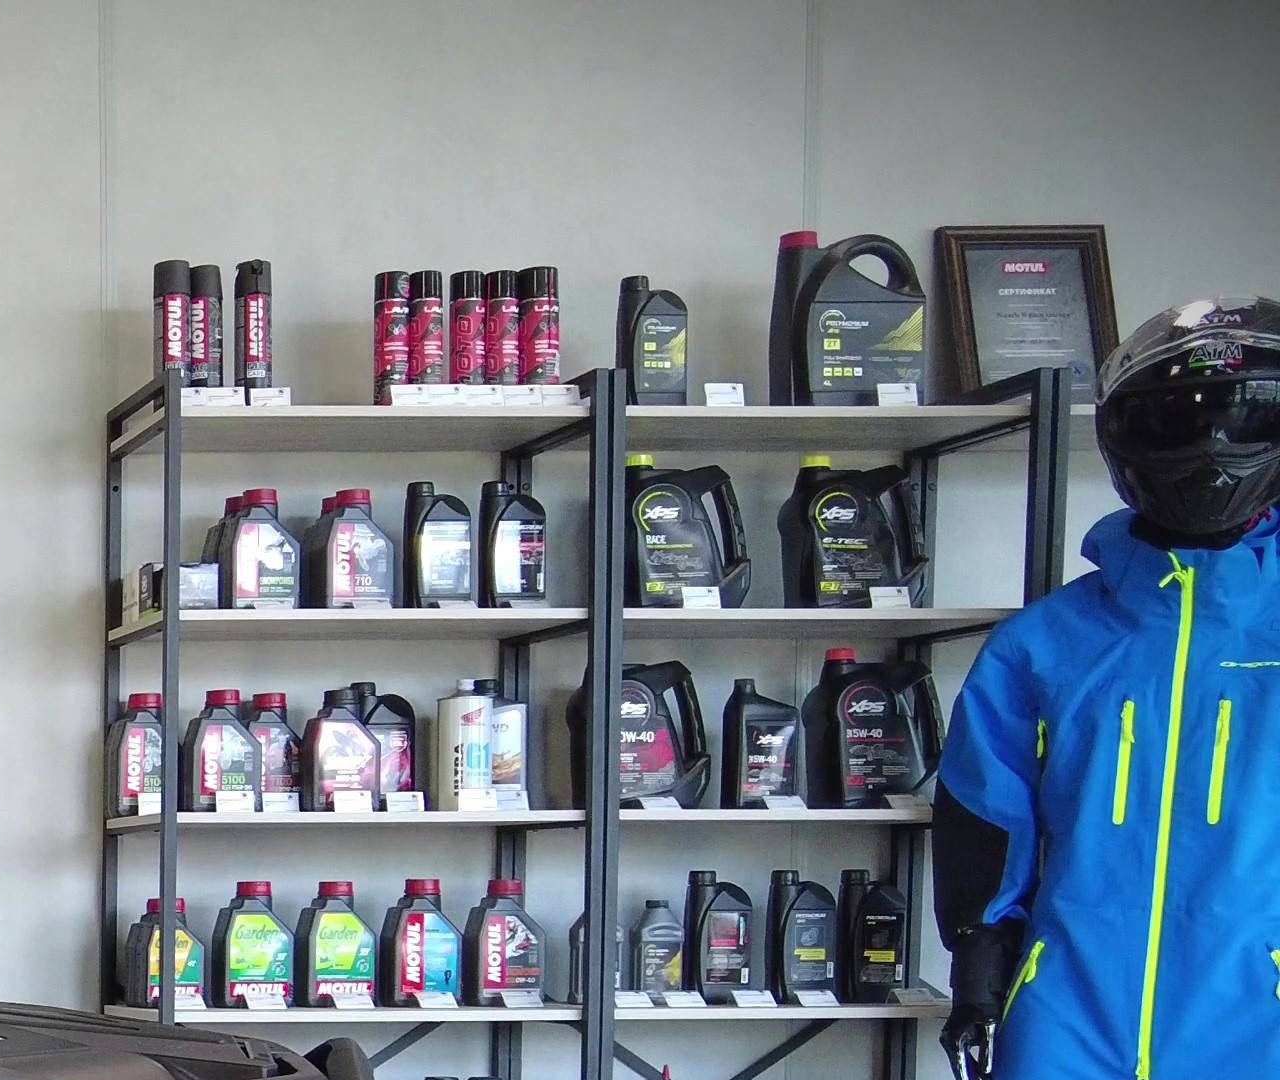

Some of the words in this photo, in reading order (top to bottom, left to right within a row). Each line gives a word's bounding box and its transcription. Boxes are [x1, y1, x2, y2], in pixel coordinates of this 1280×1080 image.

[1004, 263, 1046, 273] MOTUL
[167, 298, 181, 358] MOTUL
[191, 300, 204, 359] MOTUL
[643, 505, 681, 520] XPS
[821, 506, 857, 520] XPS
[646, 535, 667, 544] RACE
[354, 576, 372, 586] 710
[848, 699, 887, 713] XPS
[756, 733, 785, 745] XPS
[127, 735, 140, 792] MOTUL
[204, 733, 219, 791] MOTUL
[144, 776, 161, 786] 510
[222, 776, 245, 785] 5100
[235, 924, 279, 941] Garden
[319, 925, 358, 941] Garden
[406, 921, 421, 984] MOTUL
[487, 923, 502, 983] MOTUL
[233, 983, 286, 997] MOTUL
[317, 982, 372, 995] MOTUL
